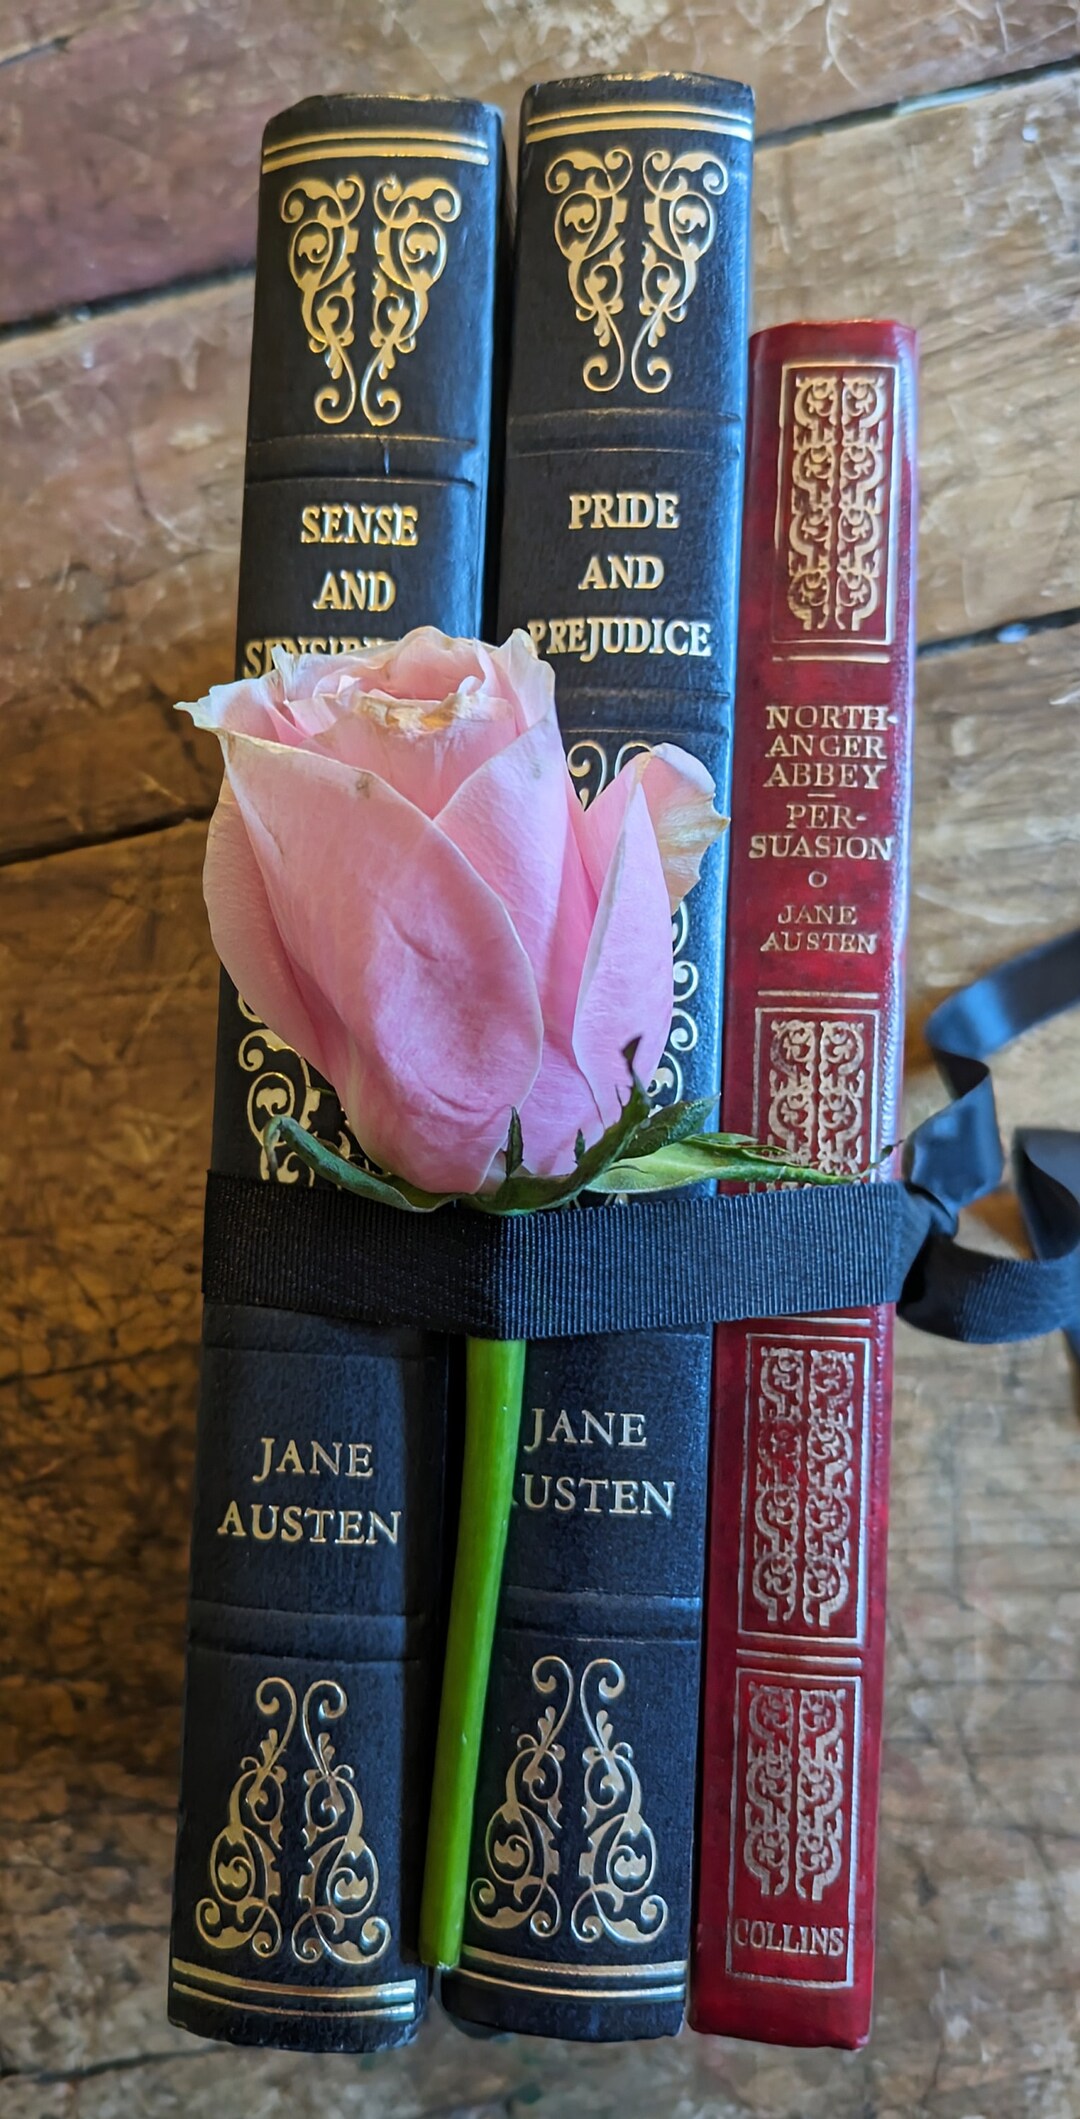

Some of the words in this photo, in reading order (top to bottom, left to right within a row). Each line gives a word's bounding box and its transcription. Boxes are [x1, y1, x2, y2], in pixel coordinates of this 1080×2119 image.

[301, 504, 419, 547] SENSE
[568, 491, 680, 530] PRIDE
[312, 570, 396, 612] AND
[578, 555, 665, 591] AND
[528, 616, 712, 662] PREJUDICE
[766, 705, 898, 731] NORTH-
[765, 734, 888, 760] ANGER
[763, 763, 887, 790] ABBEY
[786, 804, 867, 829] PER-
[748, 835, 895, 861] SUASION
[778, 905, 857, 926] JANE
[760, 931, 878, 954] AUSTEN
[523, 1407, 648, 1454] JANE
[252, 1437, 374, 1484] JANE
[512, 1472, 676, 1519] USTEN
[217, 1500, 402, 1546] AUSTEN
[733, 1918, 845, 1957] COLLINS
